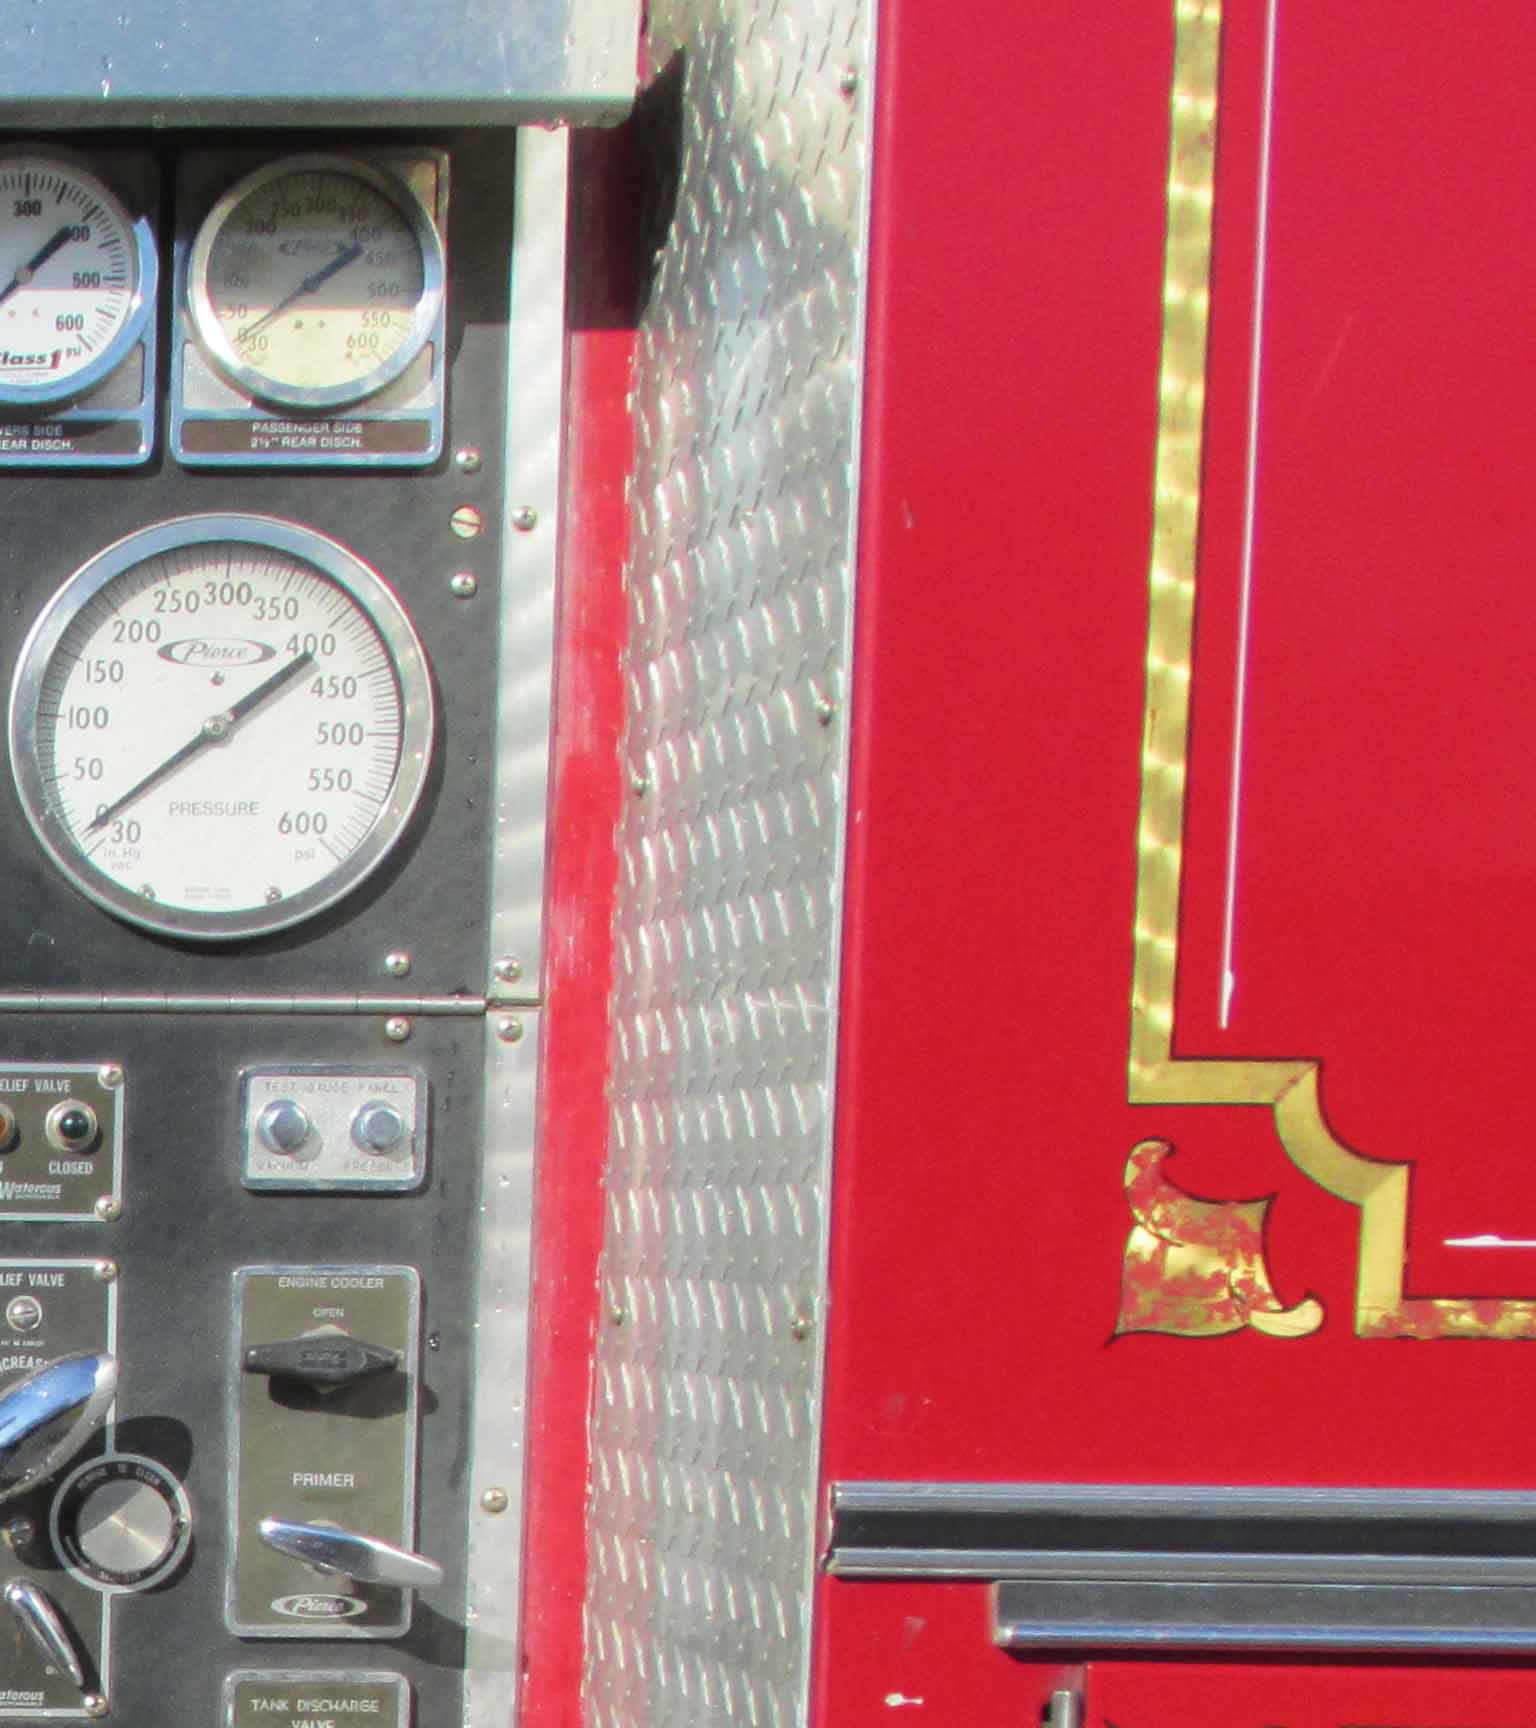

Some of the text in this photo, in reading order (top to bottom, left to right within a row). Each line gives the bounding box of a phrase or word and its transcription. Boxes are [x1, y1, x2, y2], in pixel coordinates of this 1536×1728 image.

[154, 590, 200, 614] 250
[204, 582, 252, 606] 300
[253, 596, 298, 620] 350
[113, 620, 161, 643] 200
[286, 633, 336, 657] 400
[85, 660, 124, 683] 150
[310, 676, 357, 700] 450
[67, 707, 109, 729] 100
[317, 723, 364, 746] 500
[74, 758, 103, 780] 50
[308, 770, 352, 791] 550
[169, 801, 260, 816] PRESSURE
[278, 812, 327, 835] 600
[33, 1079, 71, 1092] VALVE
[49, 1161, 93, 1175] CLOSED
[29, 1273, 65, 1287] VALVE
[278, 1277, 383, 1289] ENGINE COOLER
[293, 1472, 355, 1488] PRIMER
[251, 1699, 379, 1714] TANK DISCHARGE
